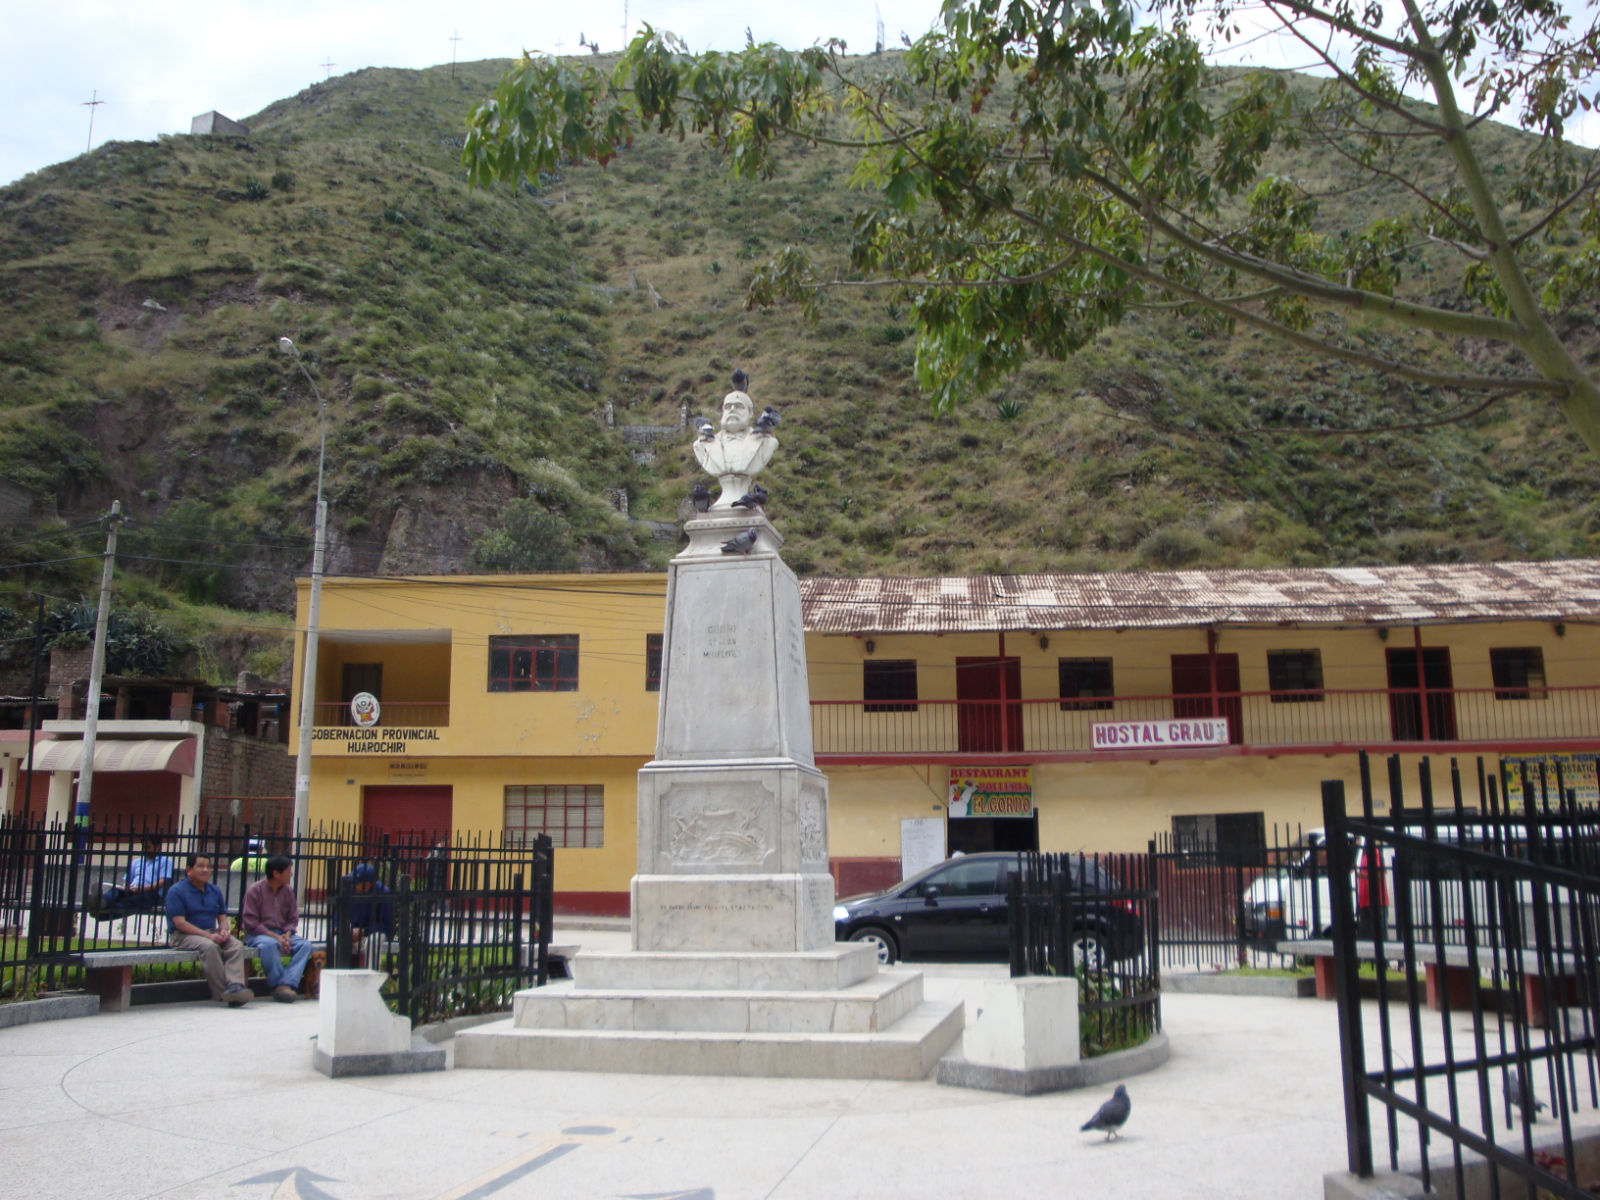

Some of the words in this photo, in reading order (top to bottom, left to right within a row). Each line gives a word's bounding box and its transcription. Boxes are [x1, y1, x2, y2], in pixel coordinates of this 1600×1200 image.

[311, 729, 378, 740] GOBERNACION
[382, 729, 440, 740] PROVINCIAL
[1095, 724, 1164, 744] HOSTAL
[1168, 722, 1214, 742] GRAU
[347, 742, 406, 753] HUAROCHIRI
[950, 768, 1029, 778] RESTAURANT
[972, 795, 987, 814] EL
[988, 795, 1031, 813] GORDO
